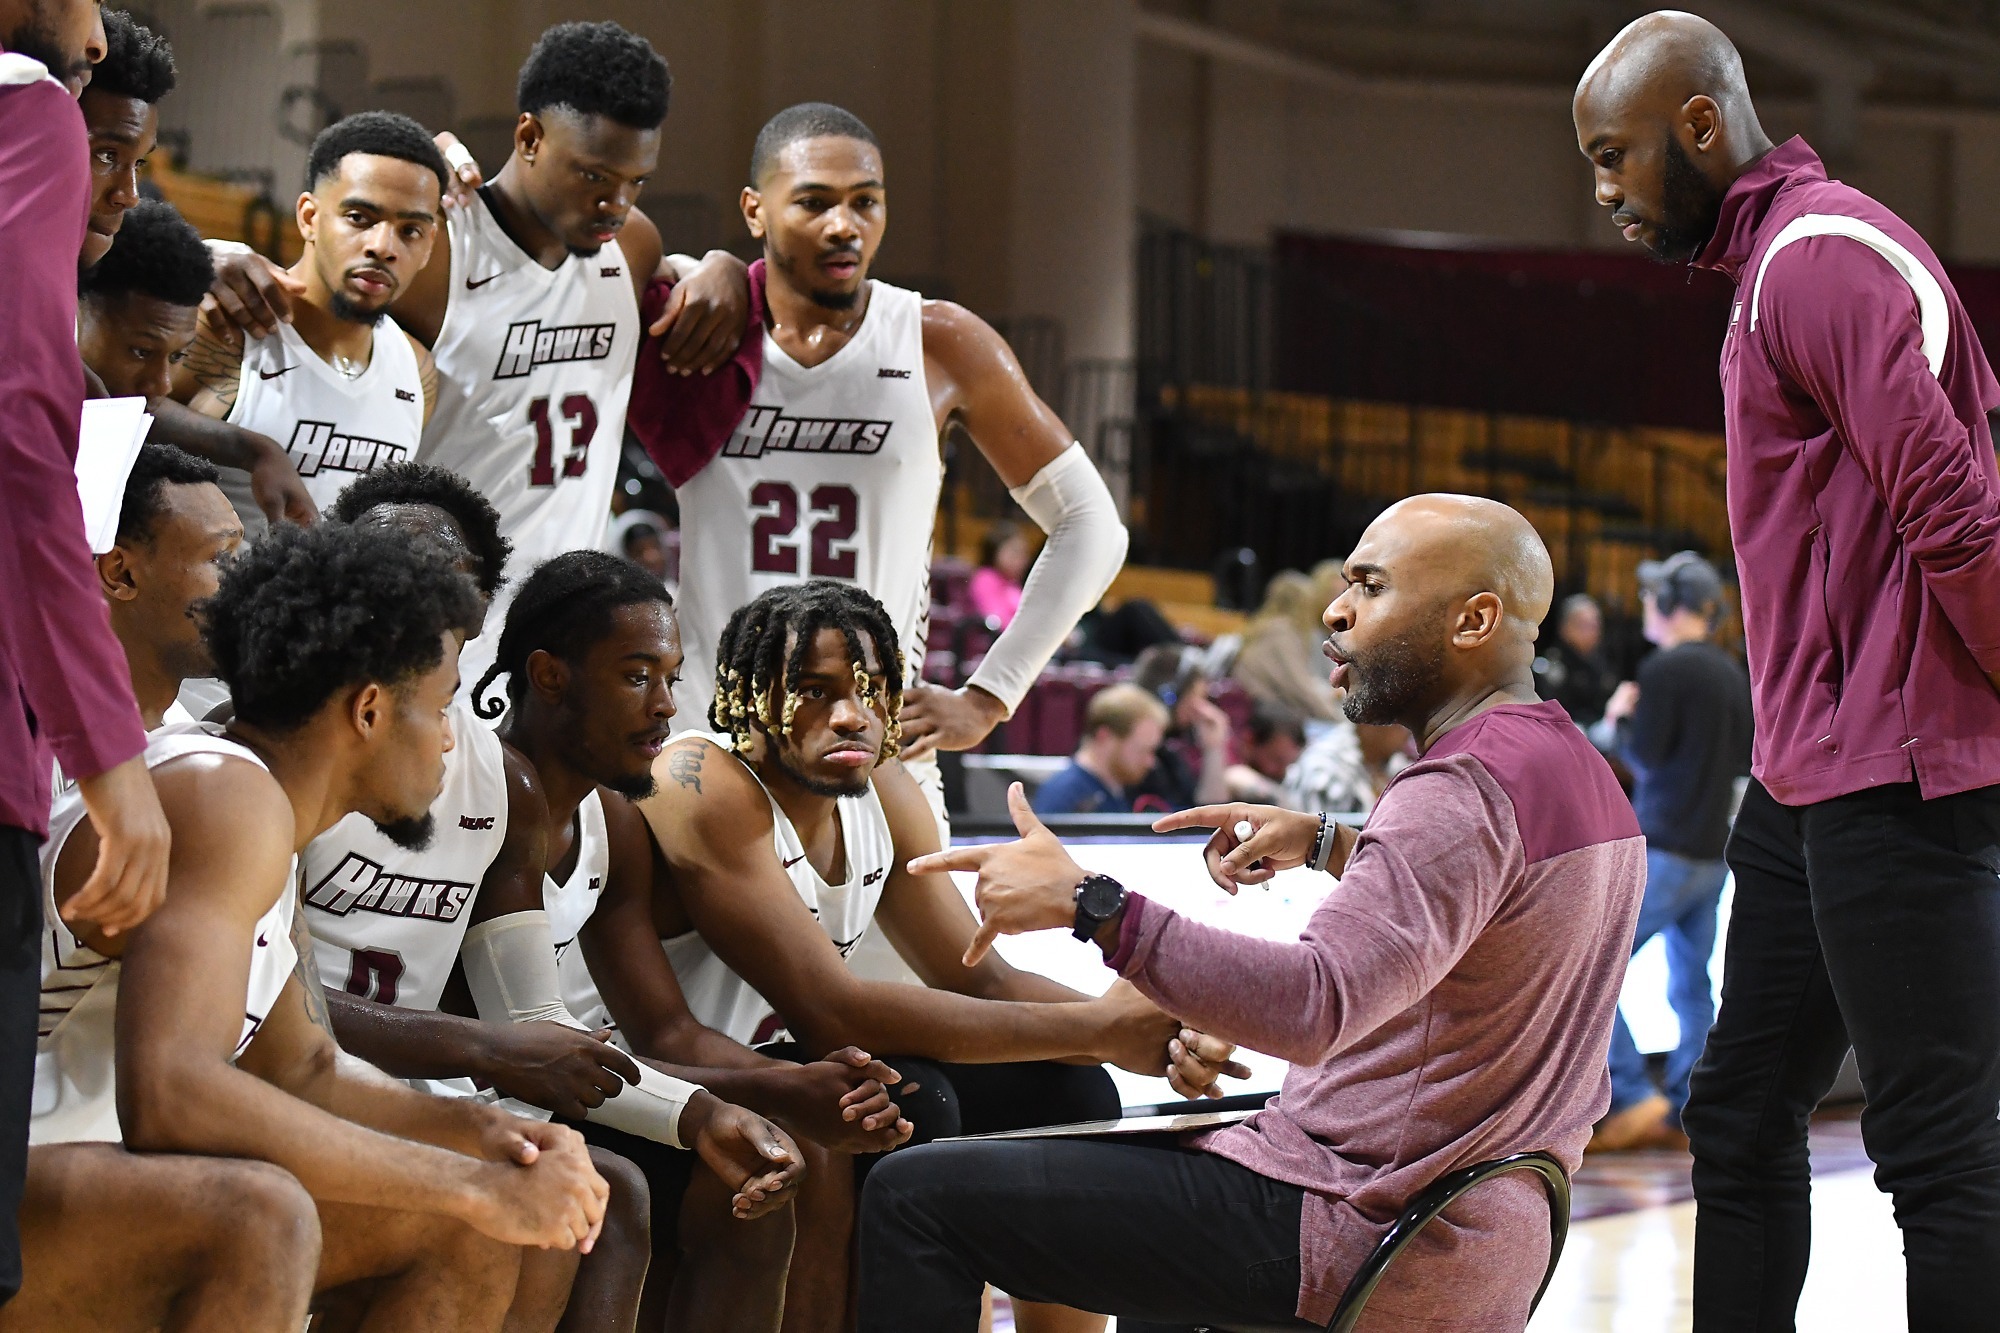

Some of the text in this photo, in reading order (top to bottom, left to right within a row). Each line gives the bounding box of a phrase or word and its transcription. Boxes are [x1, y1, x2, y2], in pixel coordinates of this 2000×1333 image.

[492, 319, 616, 380] HAWKS
[528, 391, 599, 489] 13
[721, 405, 893, 459] HAWKS
[748, 479, 860, 582] 22
[305, 851, 476, 923] HAWKS
